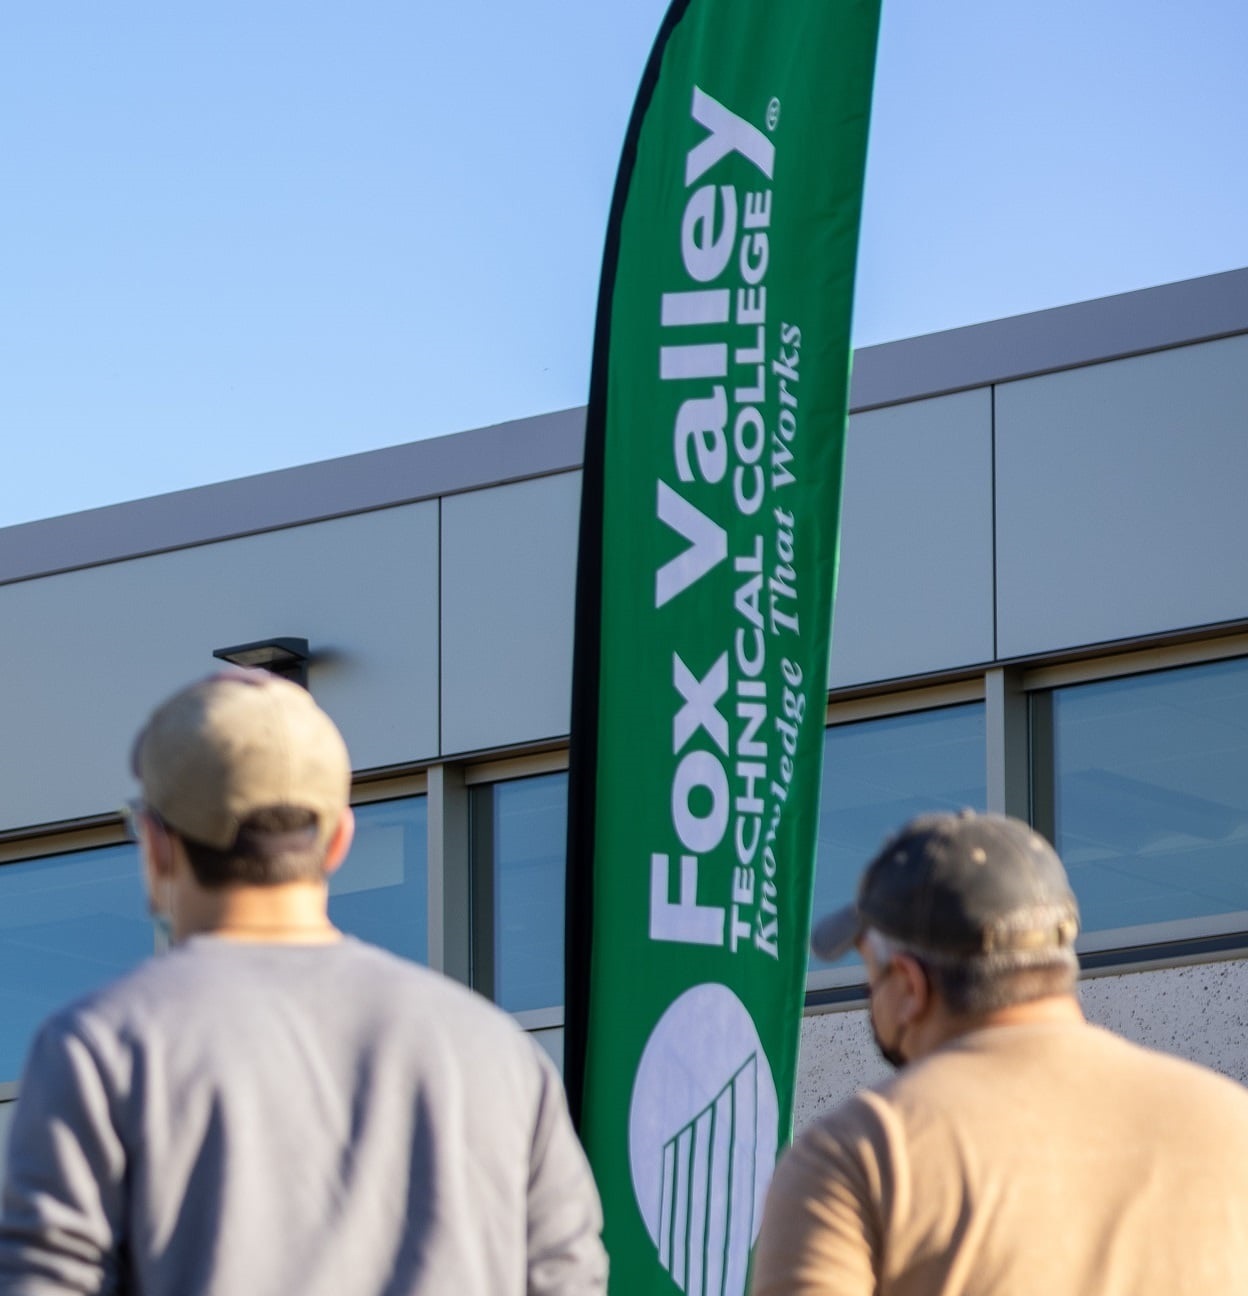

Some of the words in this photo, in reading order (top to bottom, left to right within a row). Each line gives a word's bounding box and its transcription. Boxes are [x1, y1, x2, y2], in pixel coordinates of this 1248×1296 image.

[656, 85, 775, 608] Valley
[734, 190, 772, 515] COLLEGE
[770, 322, 802, 492] Works
[769, 506, 800, 637] That
[649, 651, 729, 945] Fox
[731, 535, 768, 953] TECHNICAL
[756, 658, 805, 960] Knowledge
